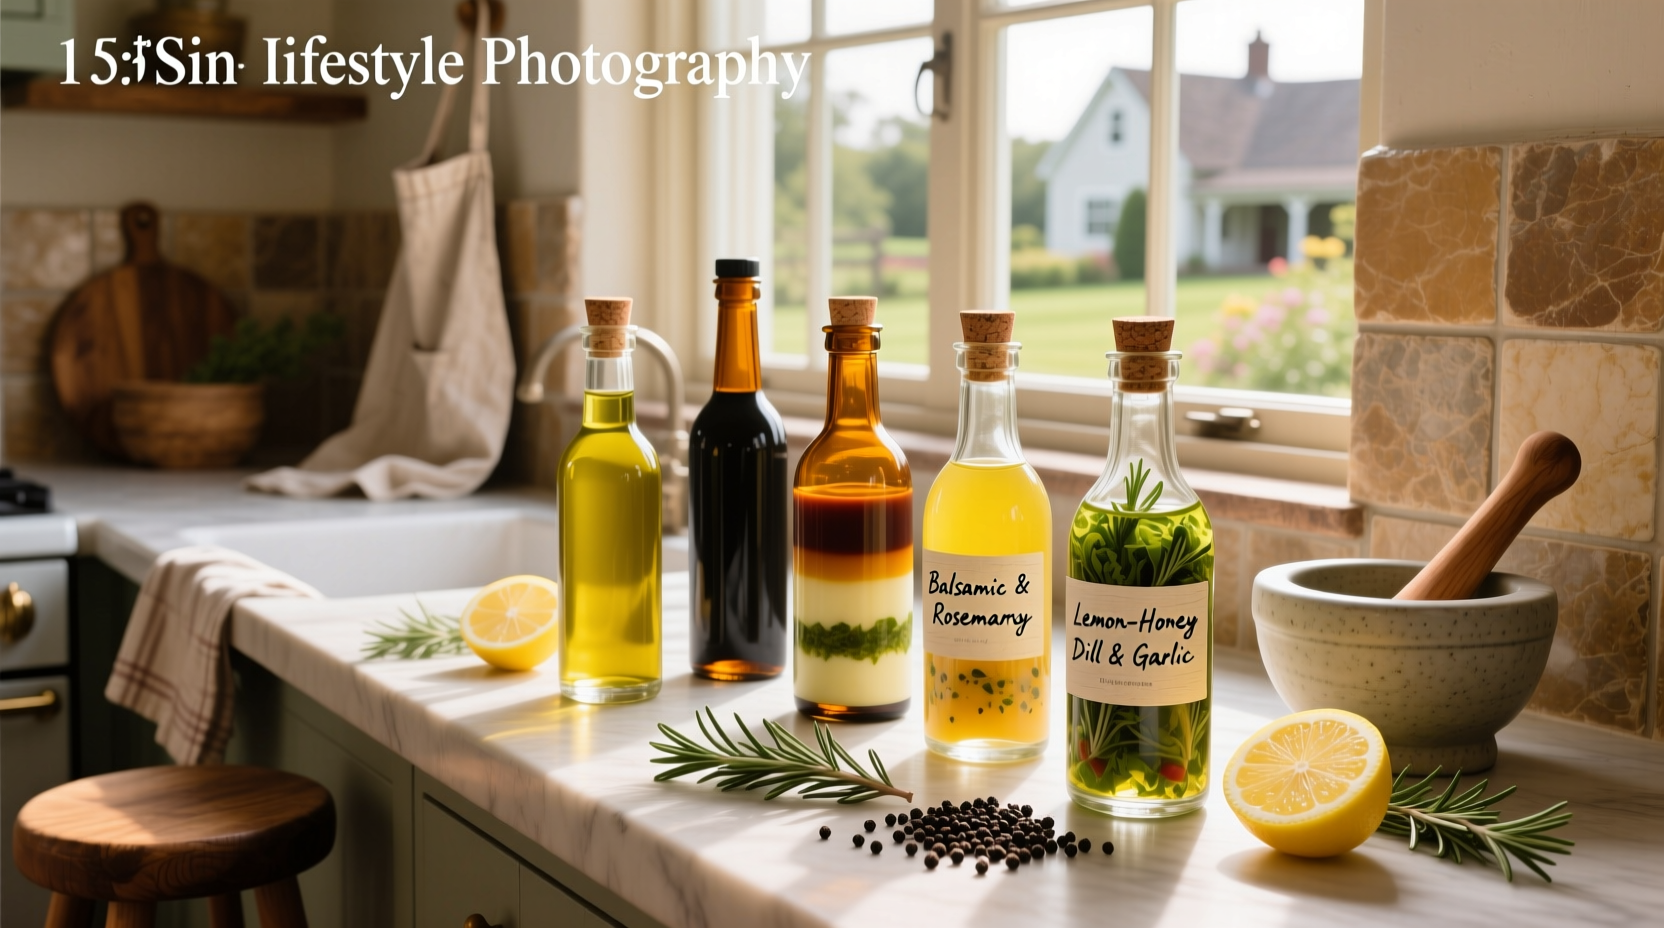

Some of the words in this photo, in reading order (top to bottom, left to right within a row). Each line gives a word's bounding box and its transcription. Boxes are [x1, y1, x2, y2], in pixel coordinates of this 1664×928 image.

[928, 570, 1007, 596] Balsamic
[1014, 573, 1031, 595] &
[1073, 601, 1199, 640] Lemon-Honey
[1072, 637, 1104, 664] Dill
[1108, 642, 1125, 667] &
[1132, 641, 1195, 671] Garlic
